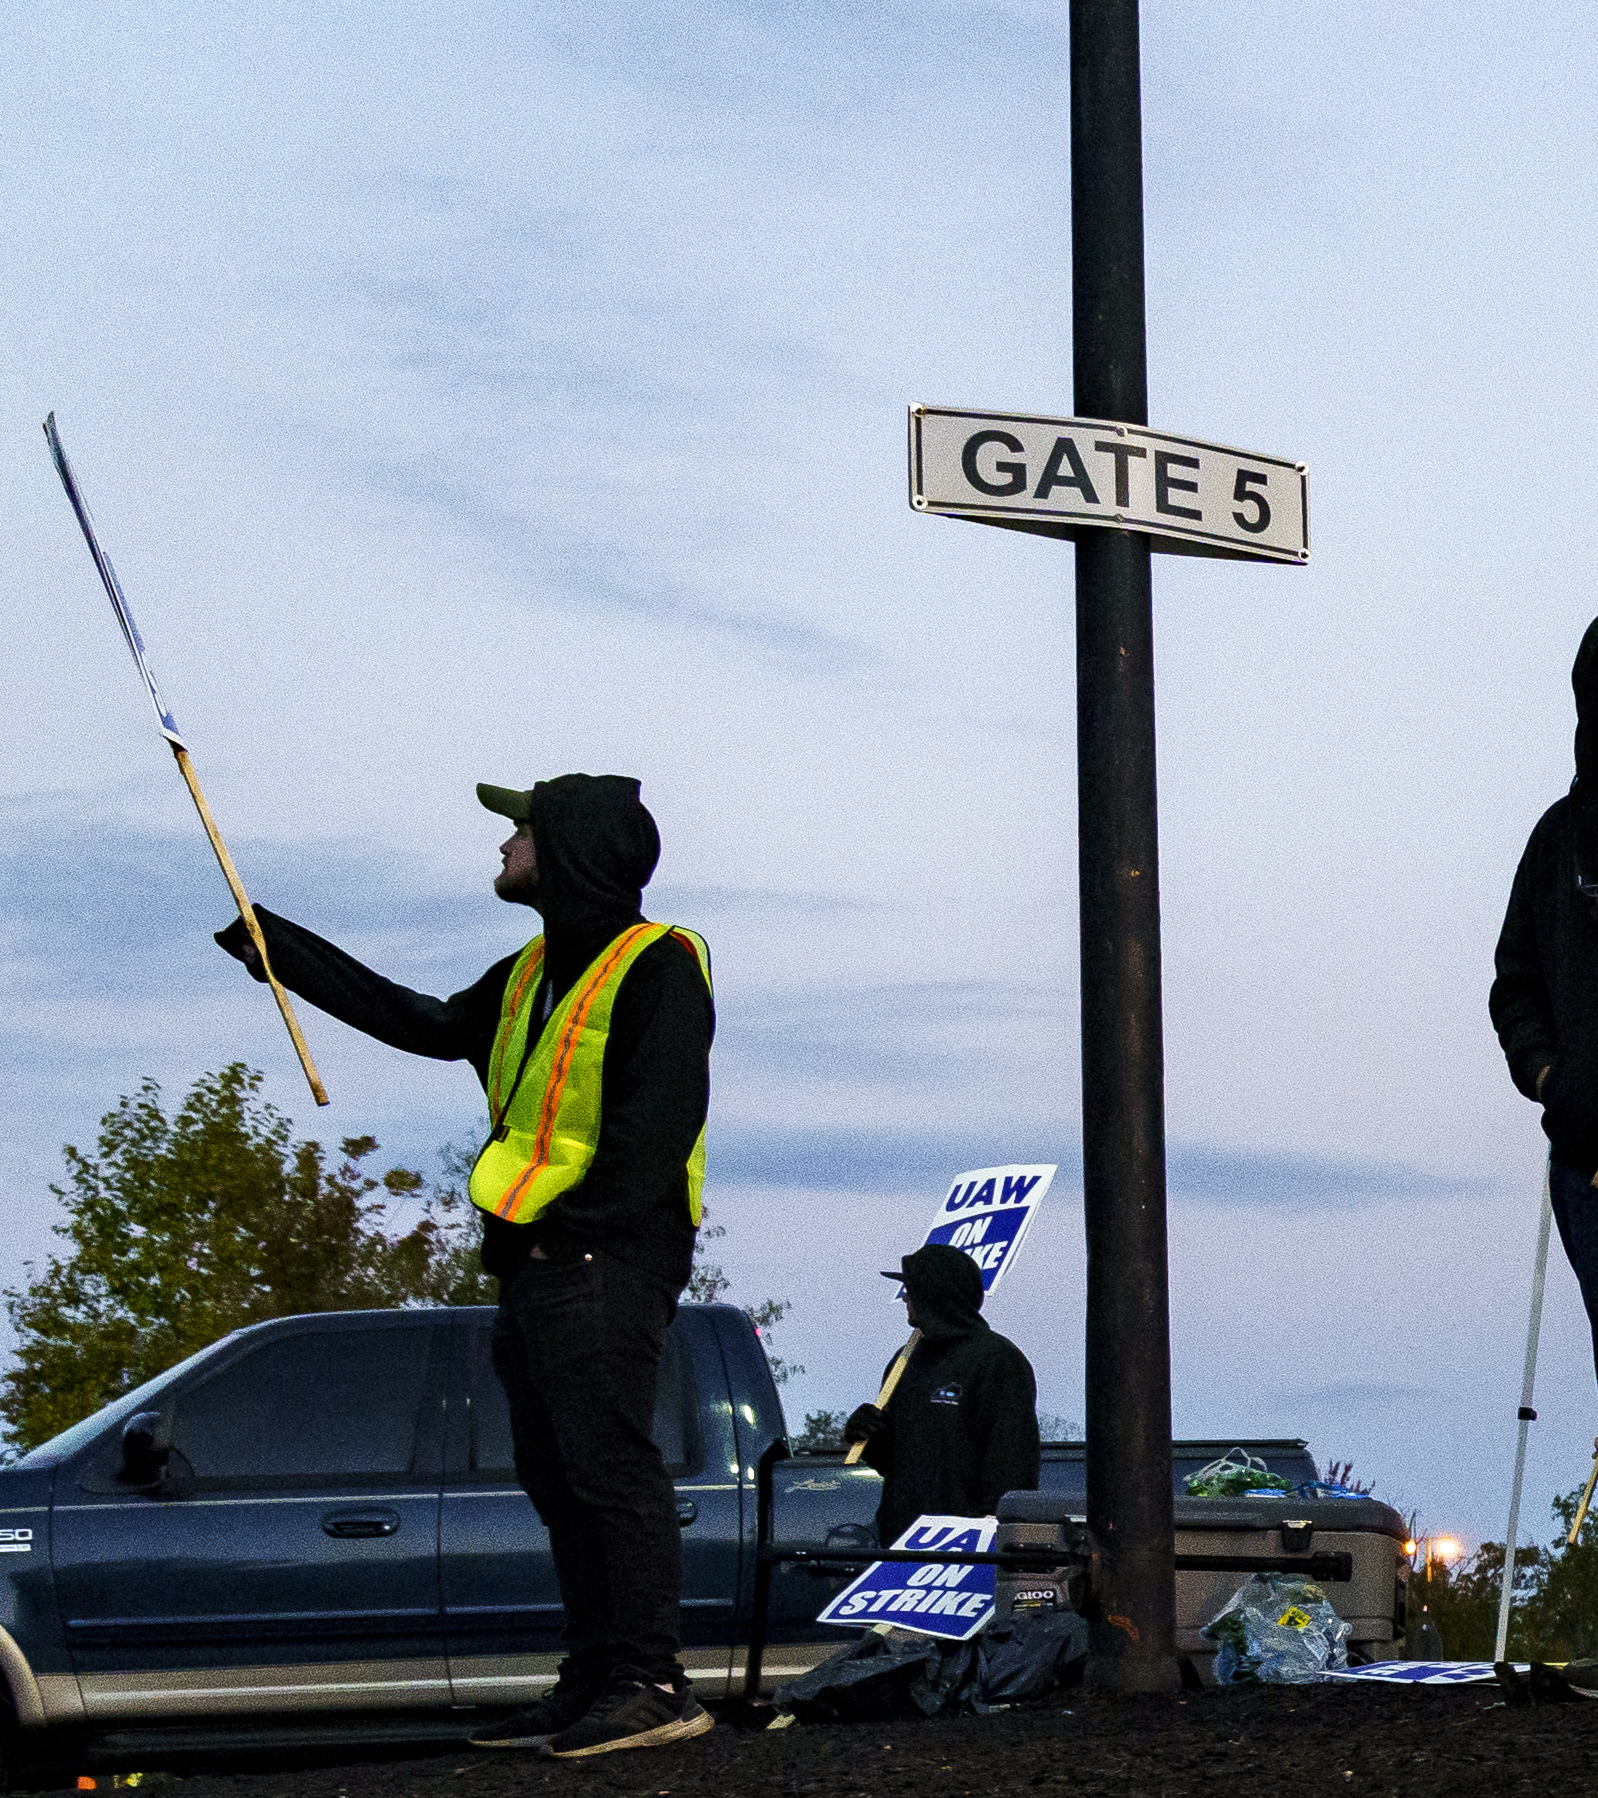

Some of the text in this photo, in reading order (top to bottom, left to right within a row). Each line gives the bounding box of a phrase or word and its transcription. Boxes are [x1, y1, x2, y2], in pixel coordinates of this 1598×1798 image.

[961, 429, 1272, 534] GATE 5
[945, 1175, 1043, 1213] UAW
[949, 1215, 993, 1249] ON
[906, 1564, 974, 1588] ON
[839, 1589, 993, 1617] STRIKE
